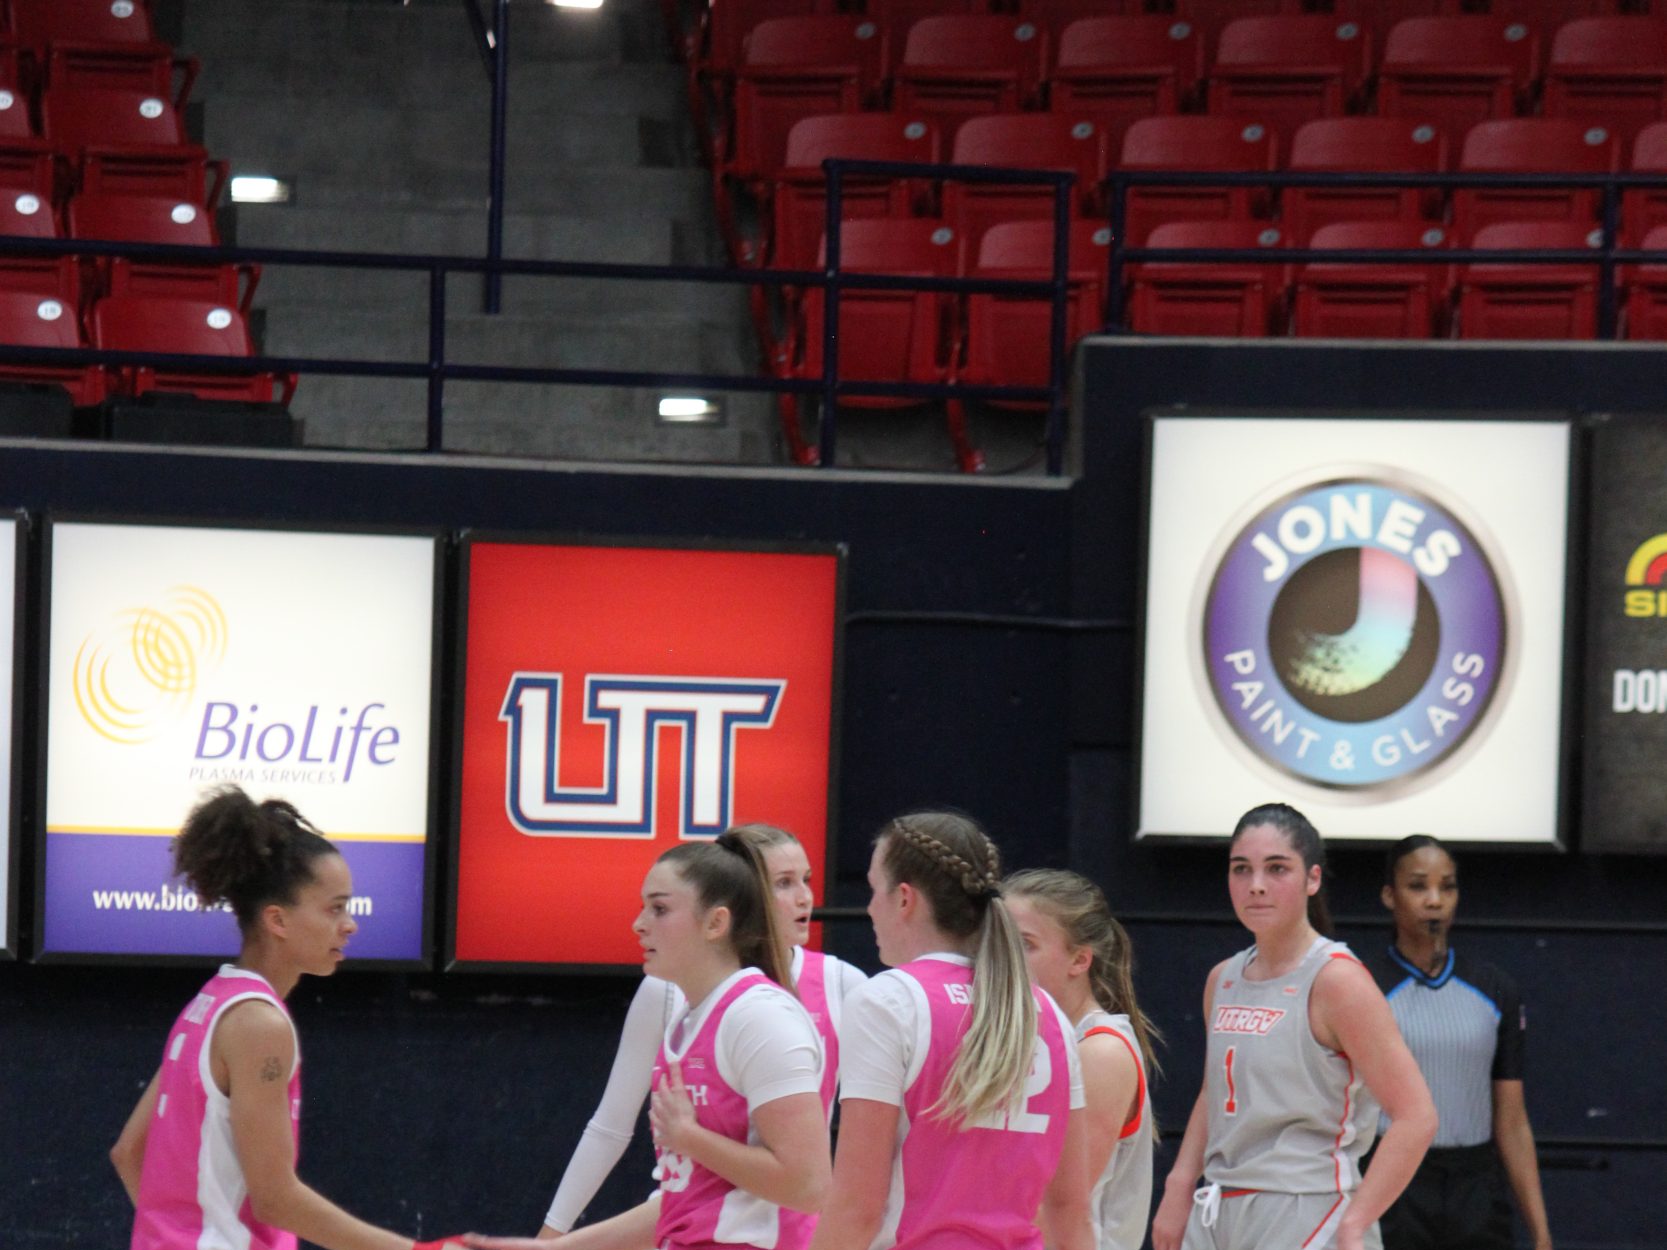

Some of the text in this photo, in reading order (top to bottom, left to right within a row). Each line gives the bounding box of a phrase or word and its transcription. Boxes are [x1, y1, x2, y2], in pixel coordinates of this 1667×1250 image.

[1250, 493, 1463, 582] JONES
[194, 701, 400, 783] BioLife
[1224, 648, 1485, 770] PAINT & GLASS
[189, 767, 337, 784] PLASMA SERVICES
[497, 670, 789, 841] UT
[1224, 1046, 1238, 1116] 1
